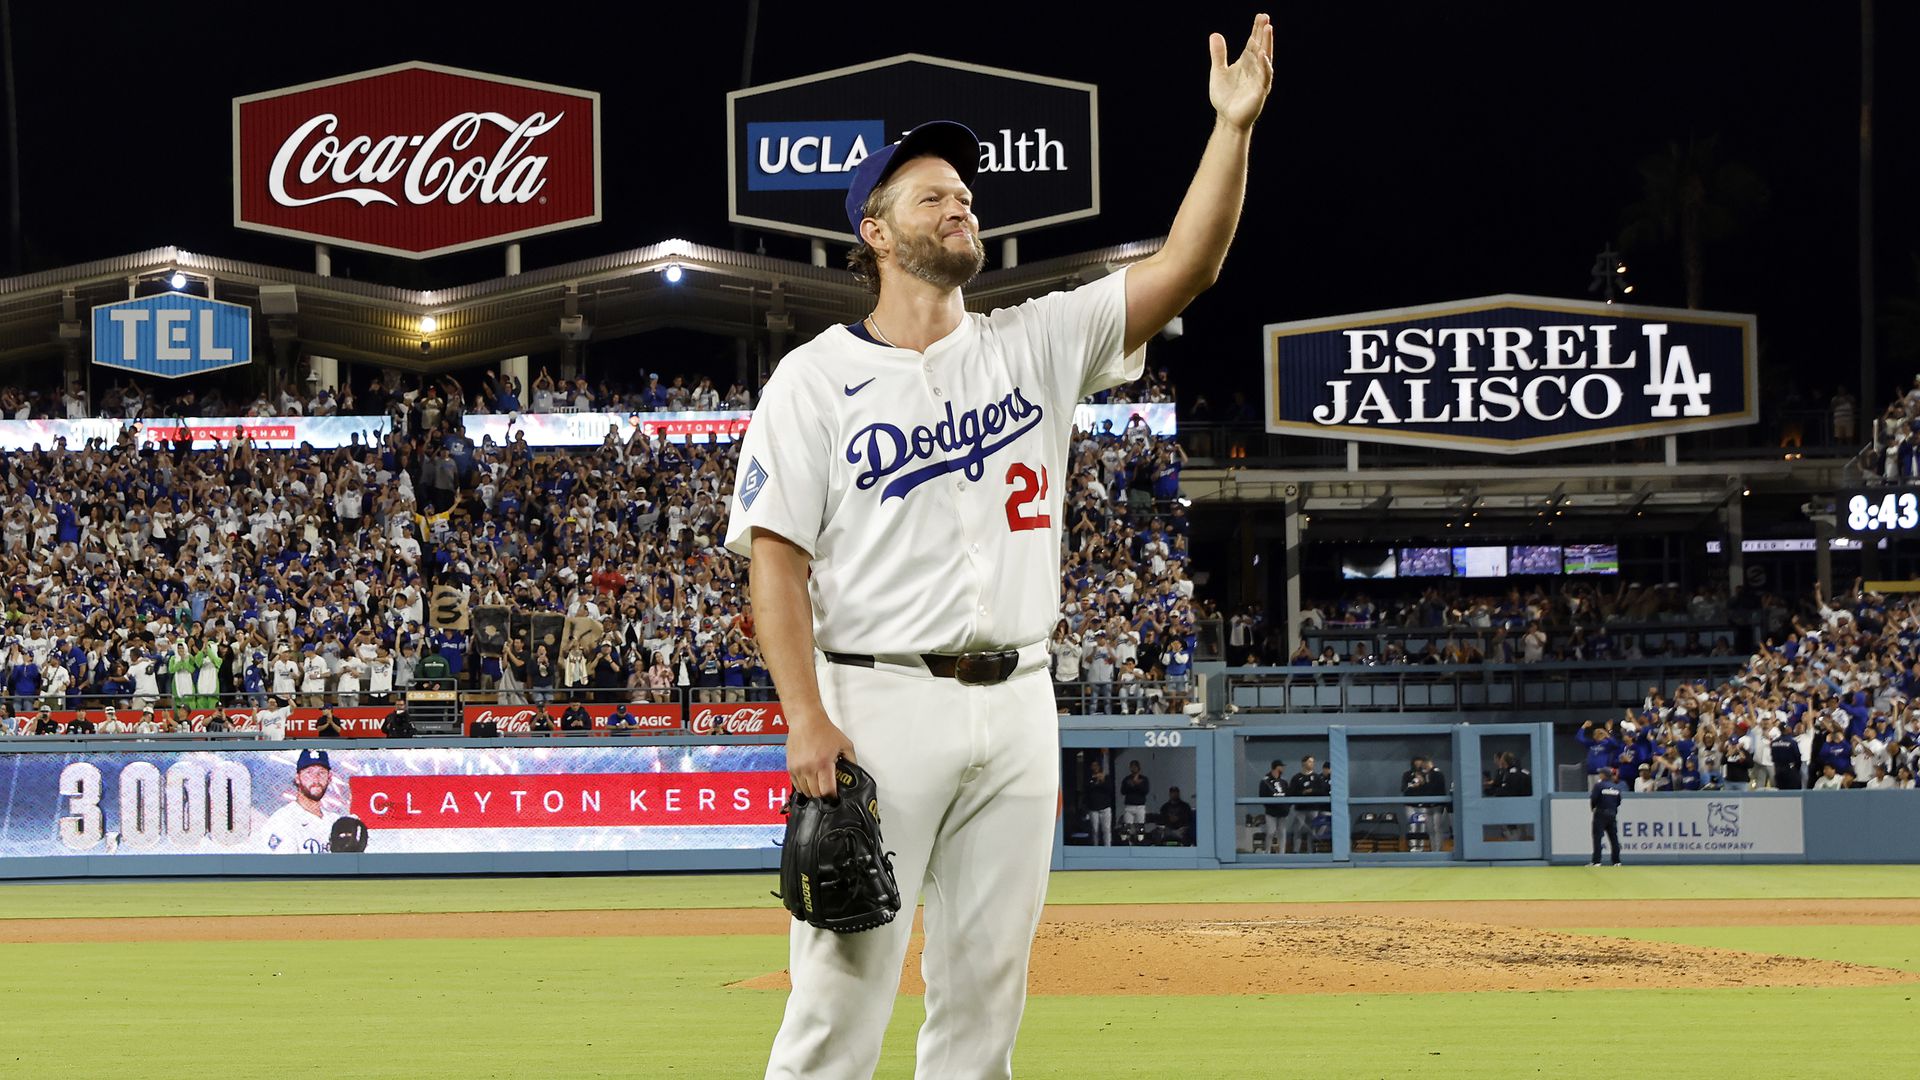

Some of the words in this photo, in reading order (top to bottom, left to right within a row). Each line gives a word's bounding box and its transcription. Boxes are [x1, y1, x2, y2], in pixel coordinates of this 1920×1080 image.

[269, 111, 565, 207] Coca-Cola
[758, 134, 870, 174] UCLA
[110, 309, 233, 361] TEL
[1343, 324, 1637, 375] ESTREL
[1642, 323, 1712, 418] LA
[1312, 372, 1624, 426] JALISCO
[644, 423, 714, 436] CAYTON
[846, 386, 1043, 507] Dodgers
[1848, 492, 1919, 531] 8:43
[307, 719, 356, 731] ERY
[358, 718, 386, 731] TIM
[1144, 730, 1181, 748] 360
[59, 760, 252, 854] 3,000
[369, 789, 601, 815] CLAYTON
[629, 786, 787, 812] KERSH
[1622, 821, 1703, 838] ERRILL
[1641, 842, 1654, 850] OF
[1656, 841, 1704, 850] AMERICA
[1704, 841, 1754, 850] COMPANY
[800, 872, 813, 912] A2000
